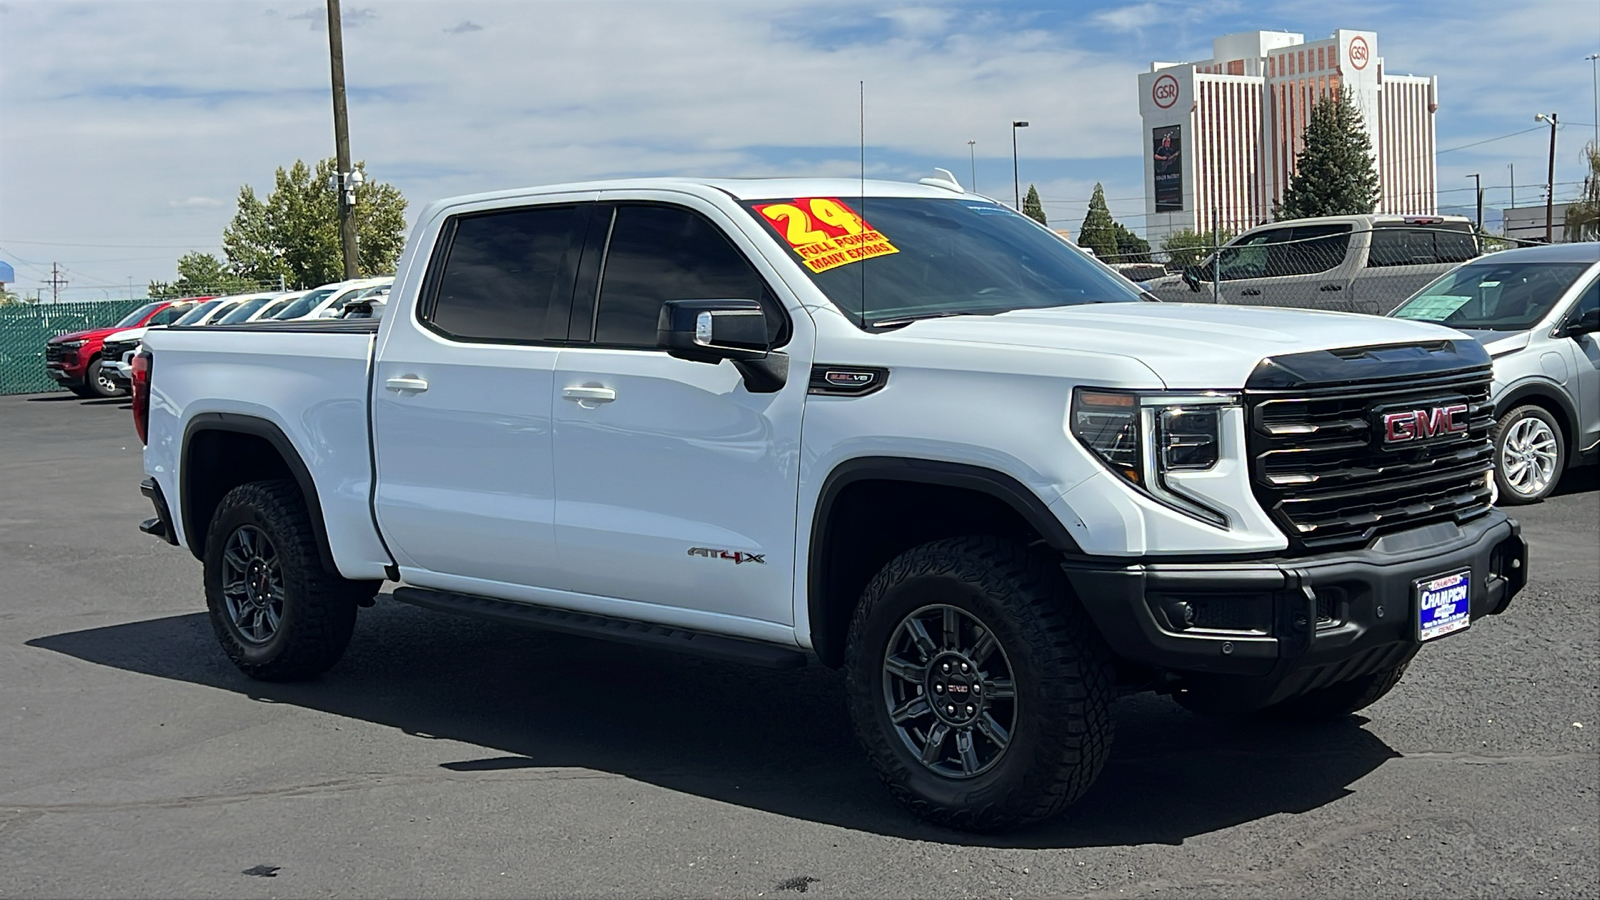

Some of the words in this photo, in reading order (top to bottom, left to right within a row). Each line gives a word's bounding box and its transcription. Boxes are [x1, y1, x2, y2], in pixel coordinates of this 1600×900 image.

[1350, 46, 1369, 61] GSR
[1156, 84, 1175, 100] GSR
[761, 198, 866, 246] 24
[800, 241, 835, 258] FULL
[836, 232, 885, 249] POWER
[809, 252, 845, 270] MANY
[849, 242, 892, 259] EXTRAS
[1384, 404, 1468, 444] GMC
[687, 546, 767, 565] AT4X
[1421, 585, 1467, 610] CHAMPION
[1438, 624, 1455, 633] RENO
